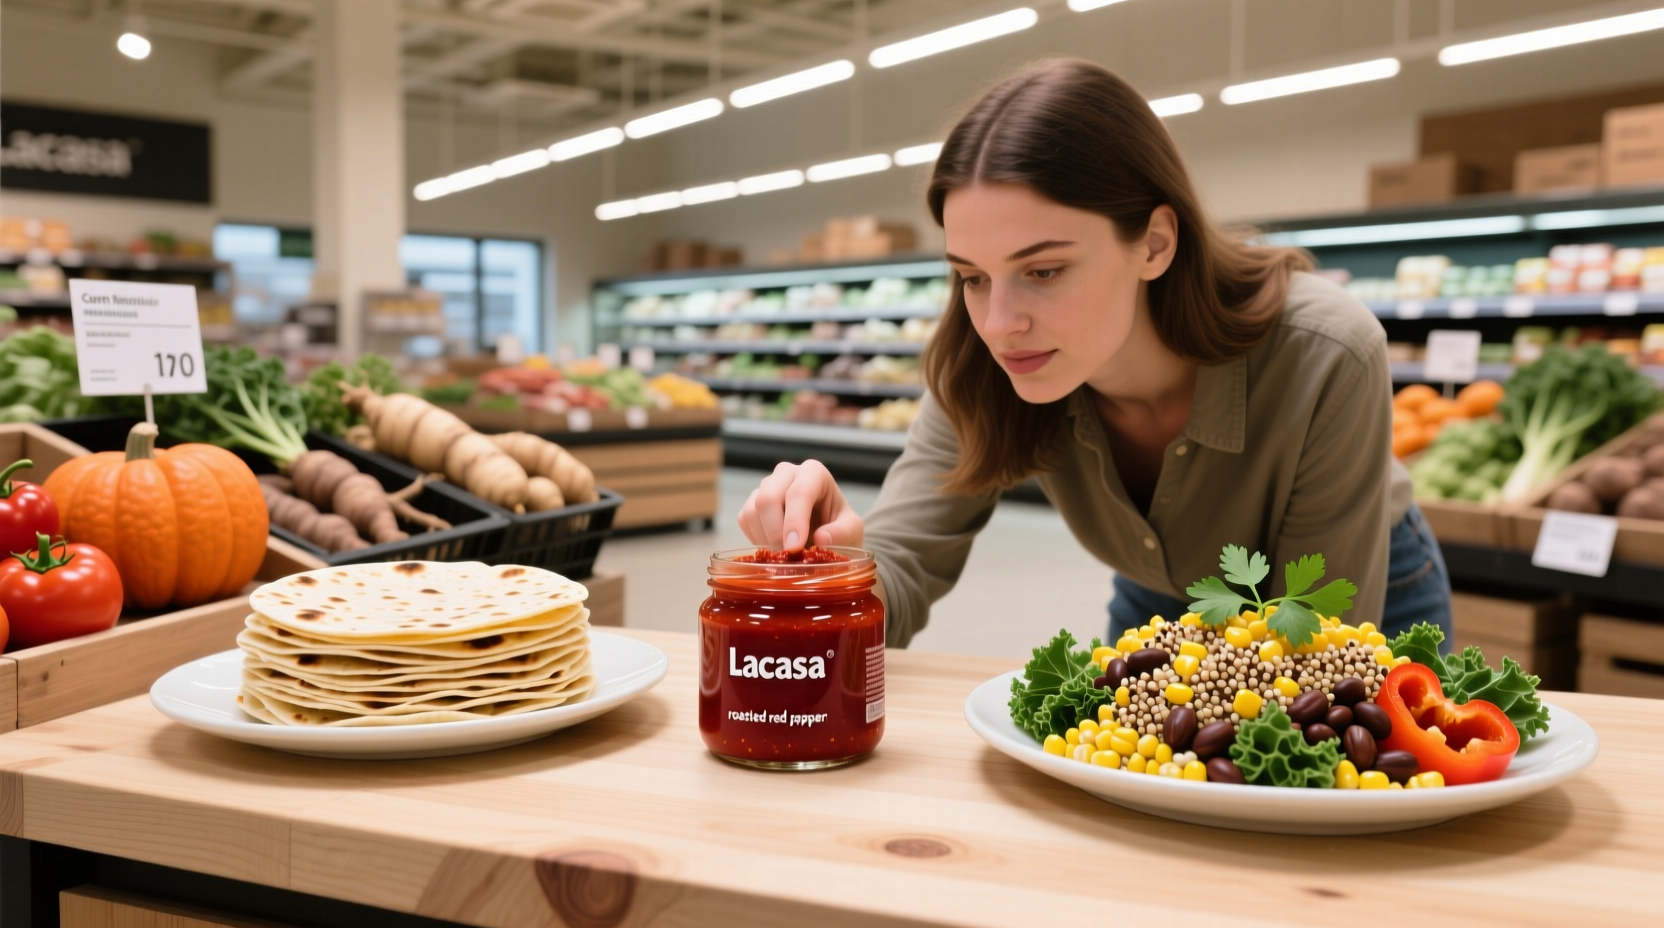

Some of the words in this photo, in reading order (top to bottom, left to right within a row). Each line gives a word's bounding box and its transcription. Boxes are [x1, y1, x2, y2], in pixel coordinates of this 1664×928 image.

[154, 352, 194, 378] 170
[729, 646, 826, 680] Lacasa
[768, 709, 787, 724] red
